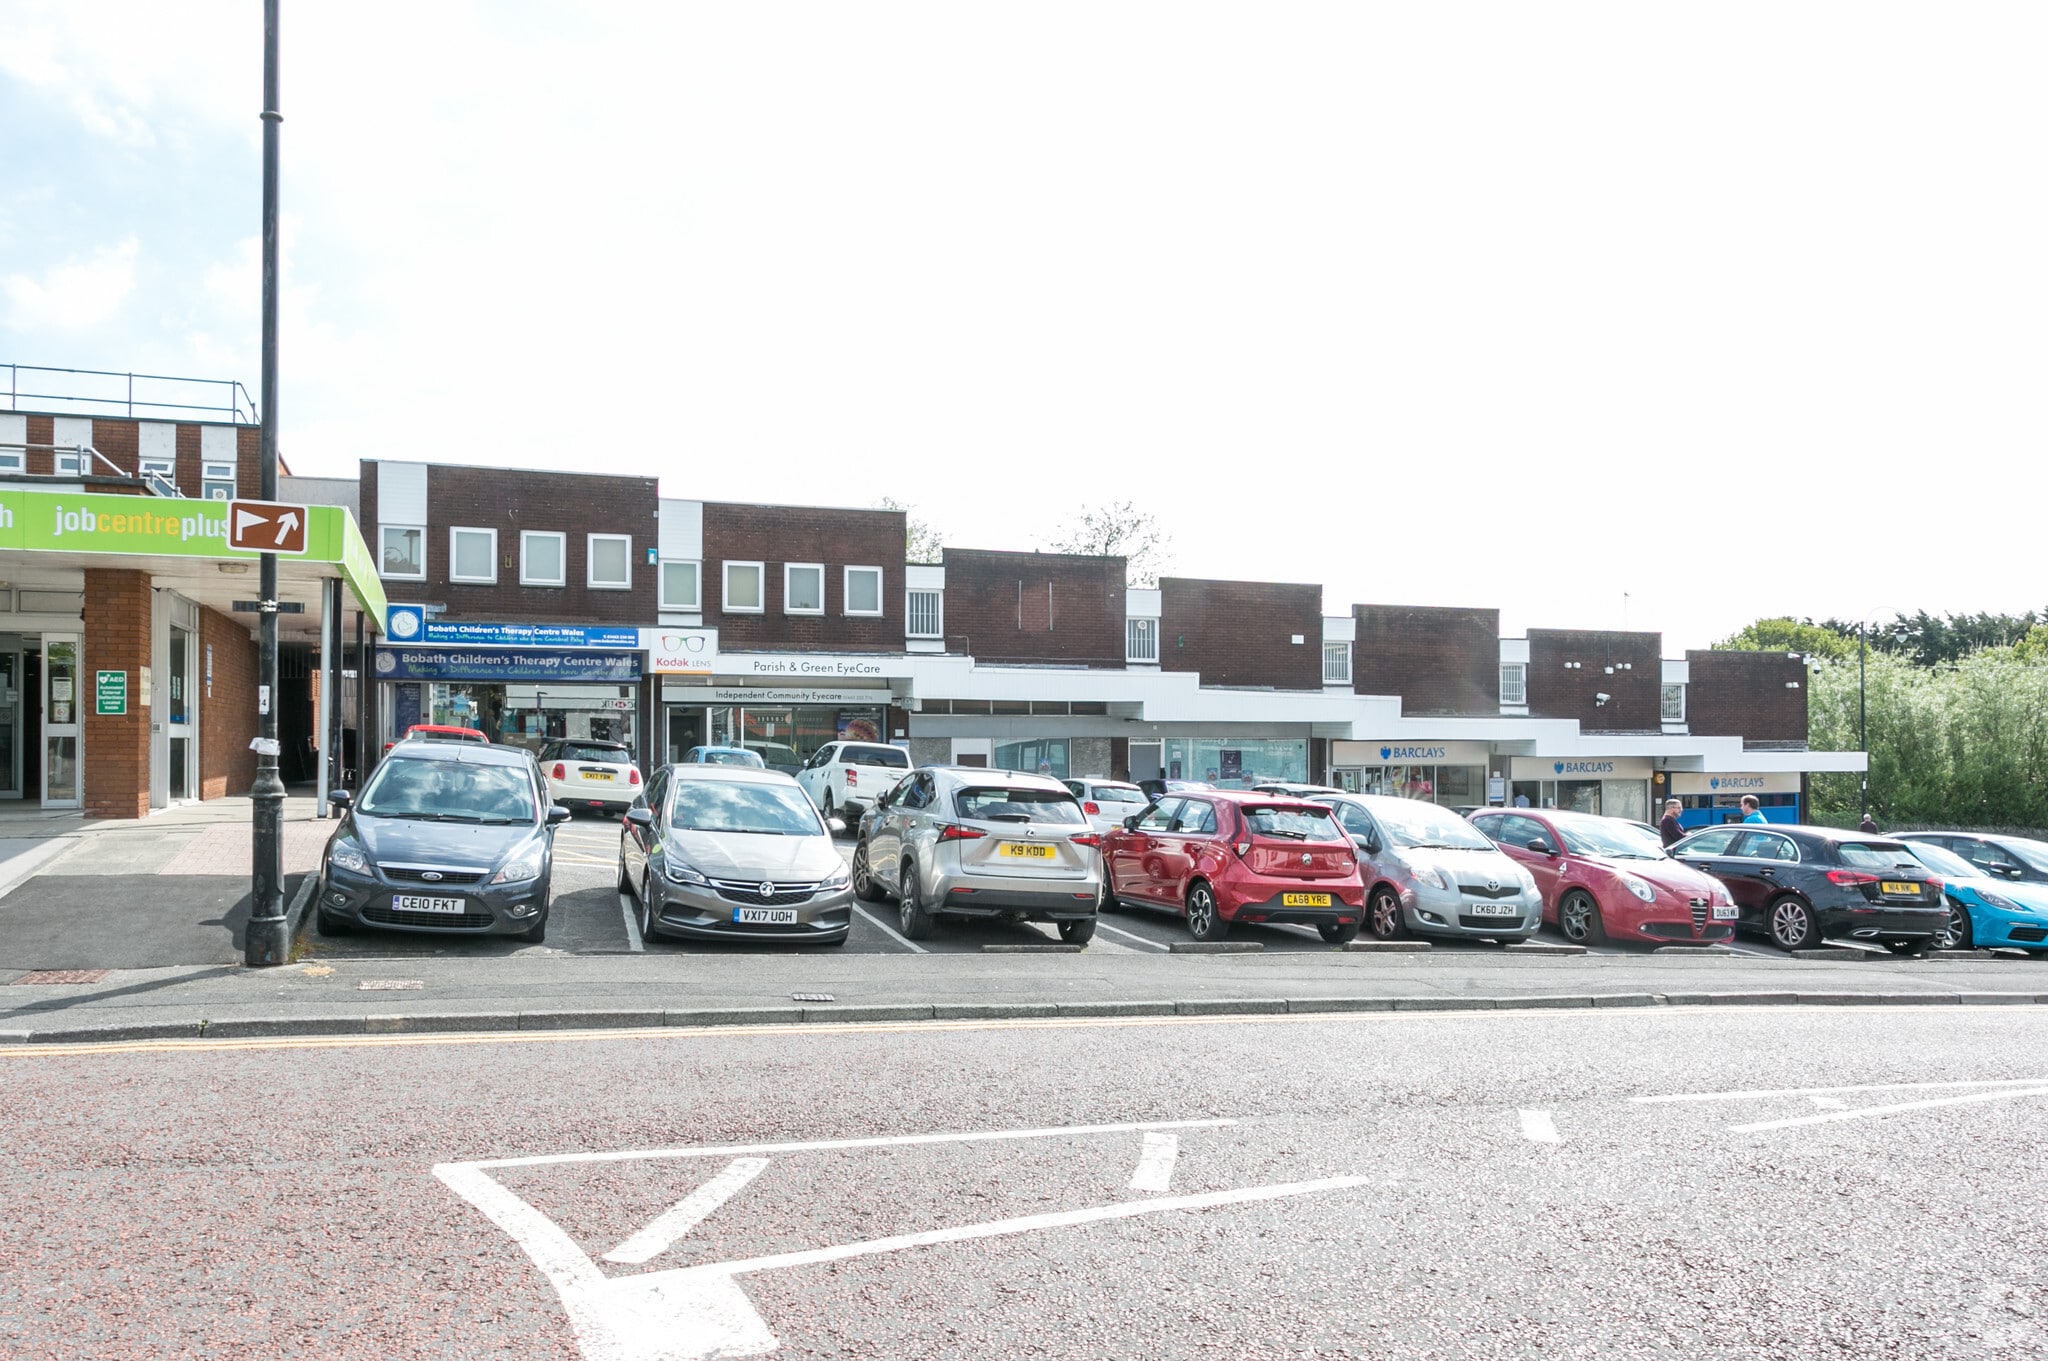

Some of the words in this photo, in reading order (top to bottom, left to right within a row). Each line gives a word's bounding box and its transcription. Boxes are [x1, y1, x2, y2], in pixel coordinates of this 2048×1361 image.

[428, 625, 458, 633] Bobath
[459, 626, 499, 634] Children's
[501, 628, 532, 636] Therapy
[534, 628, 560, 636] Centre
[402, 653, 446, 664] Bobath
[453, 654, 510, 665] Children's
[513, 655, 560, 667] Therapy
[564, 656, 602, 666] Centre
[605, 657, 638, 667] Wales
[656, 658, 689, 667] Kodak
[408, 664, 438, 676] Making
[450, 664, 494, 674] Difference
[496, 665, 504, 674] to
[507, 666, 540, 675] Children
[754, 661, 785, 672] Parish
[789, 662, 797, 672] &
[801, 662, 833, 673] Green
[837, 663, 880, 675] EyeCare
[715, 691, 764, 700] Independent
[767, 691, 809, 701] Community
[812, 692, 842, 701] Eyecare
[1393, 747, 1445, 758] BARCLAYS
[1566, 762, 1613, 773] BARCLAYS
[1721, 777, 1764, 788] BARCLAYS
[1010, 845, 1024, 856] K9
[402, 897, 430, 909] CE10
[433, 899, 458, 911] FKT
[1287, 894, 1309, 904] CA68
[1311, 895, 1328, 905] YRE
[743, 910, 769, 921] VX17
[1475, 905, 1497, 914] CK60
[1498, 905, 1514, 915] JZH
